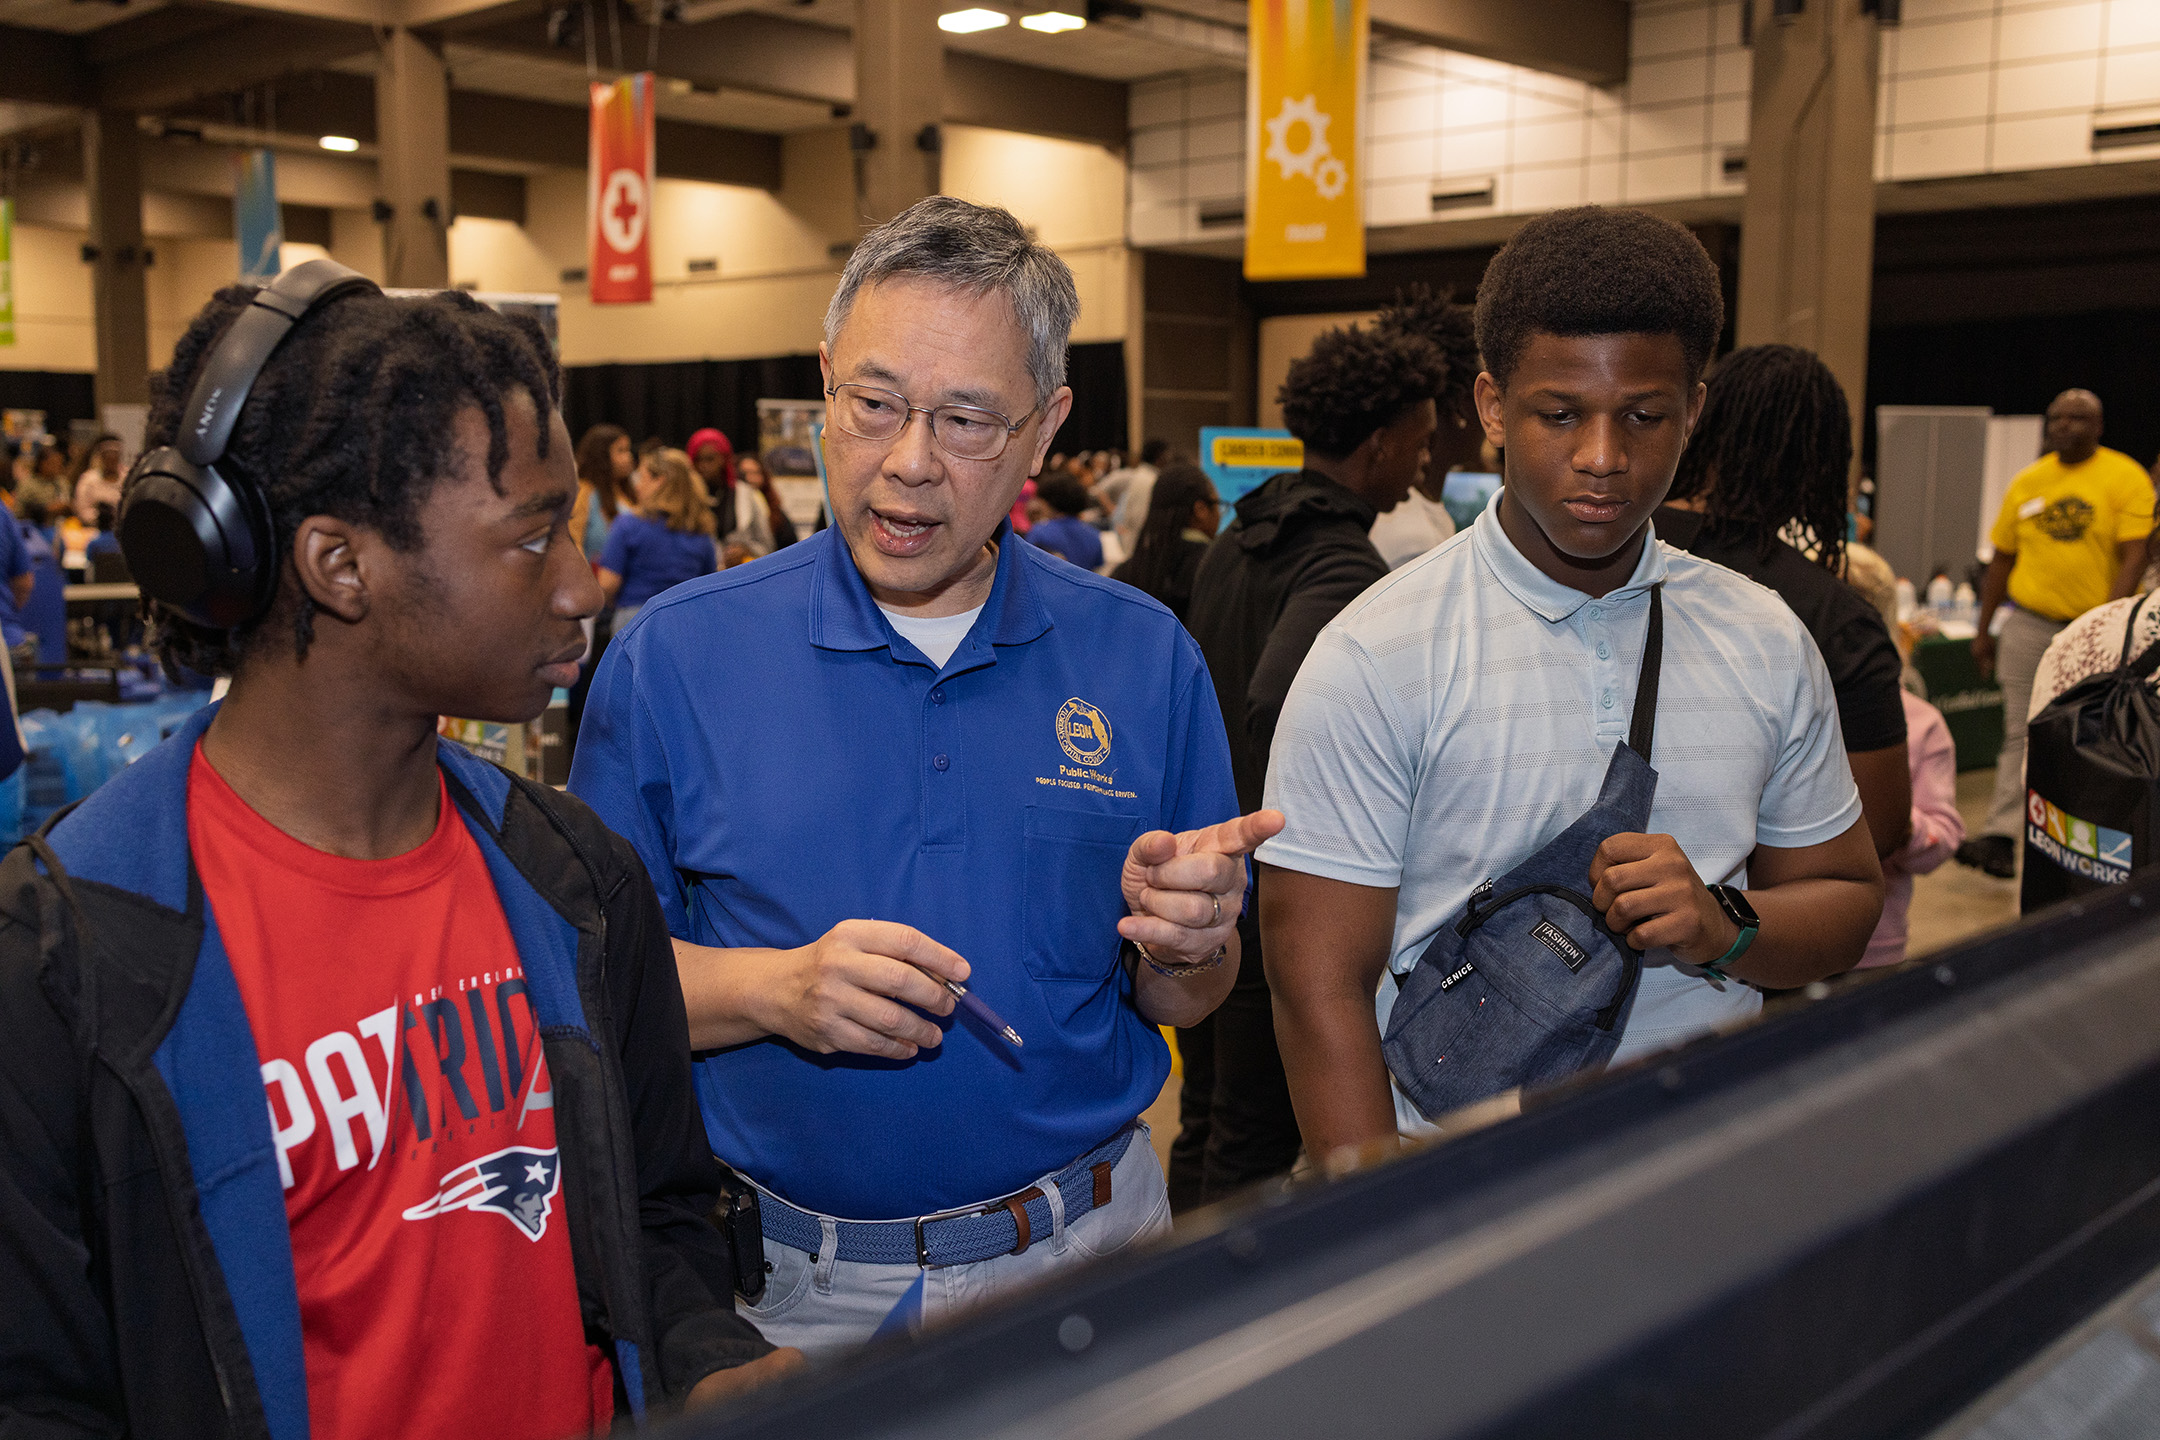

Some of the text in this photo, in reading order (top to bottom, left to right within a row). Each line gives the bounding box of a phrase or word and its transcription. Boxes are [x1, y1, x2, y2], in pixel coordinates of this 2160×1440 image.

[195, 388, 222, 438] SONY
[1068, 721, 1093, 740] LEON
[1059, 764, 1114, 785] Public Works
[1541, 926, 1580, 960] FASHION
[1441, 962, 1474, 990] CENICE
